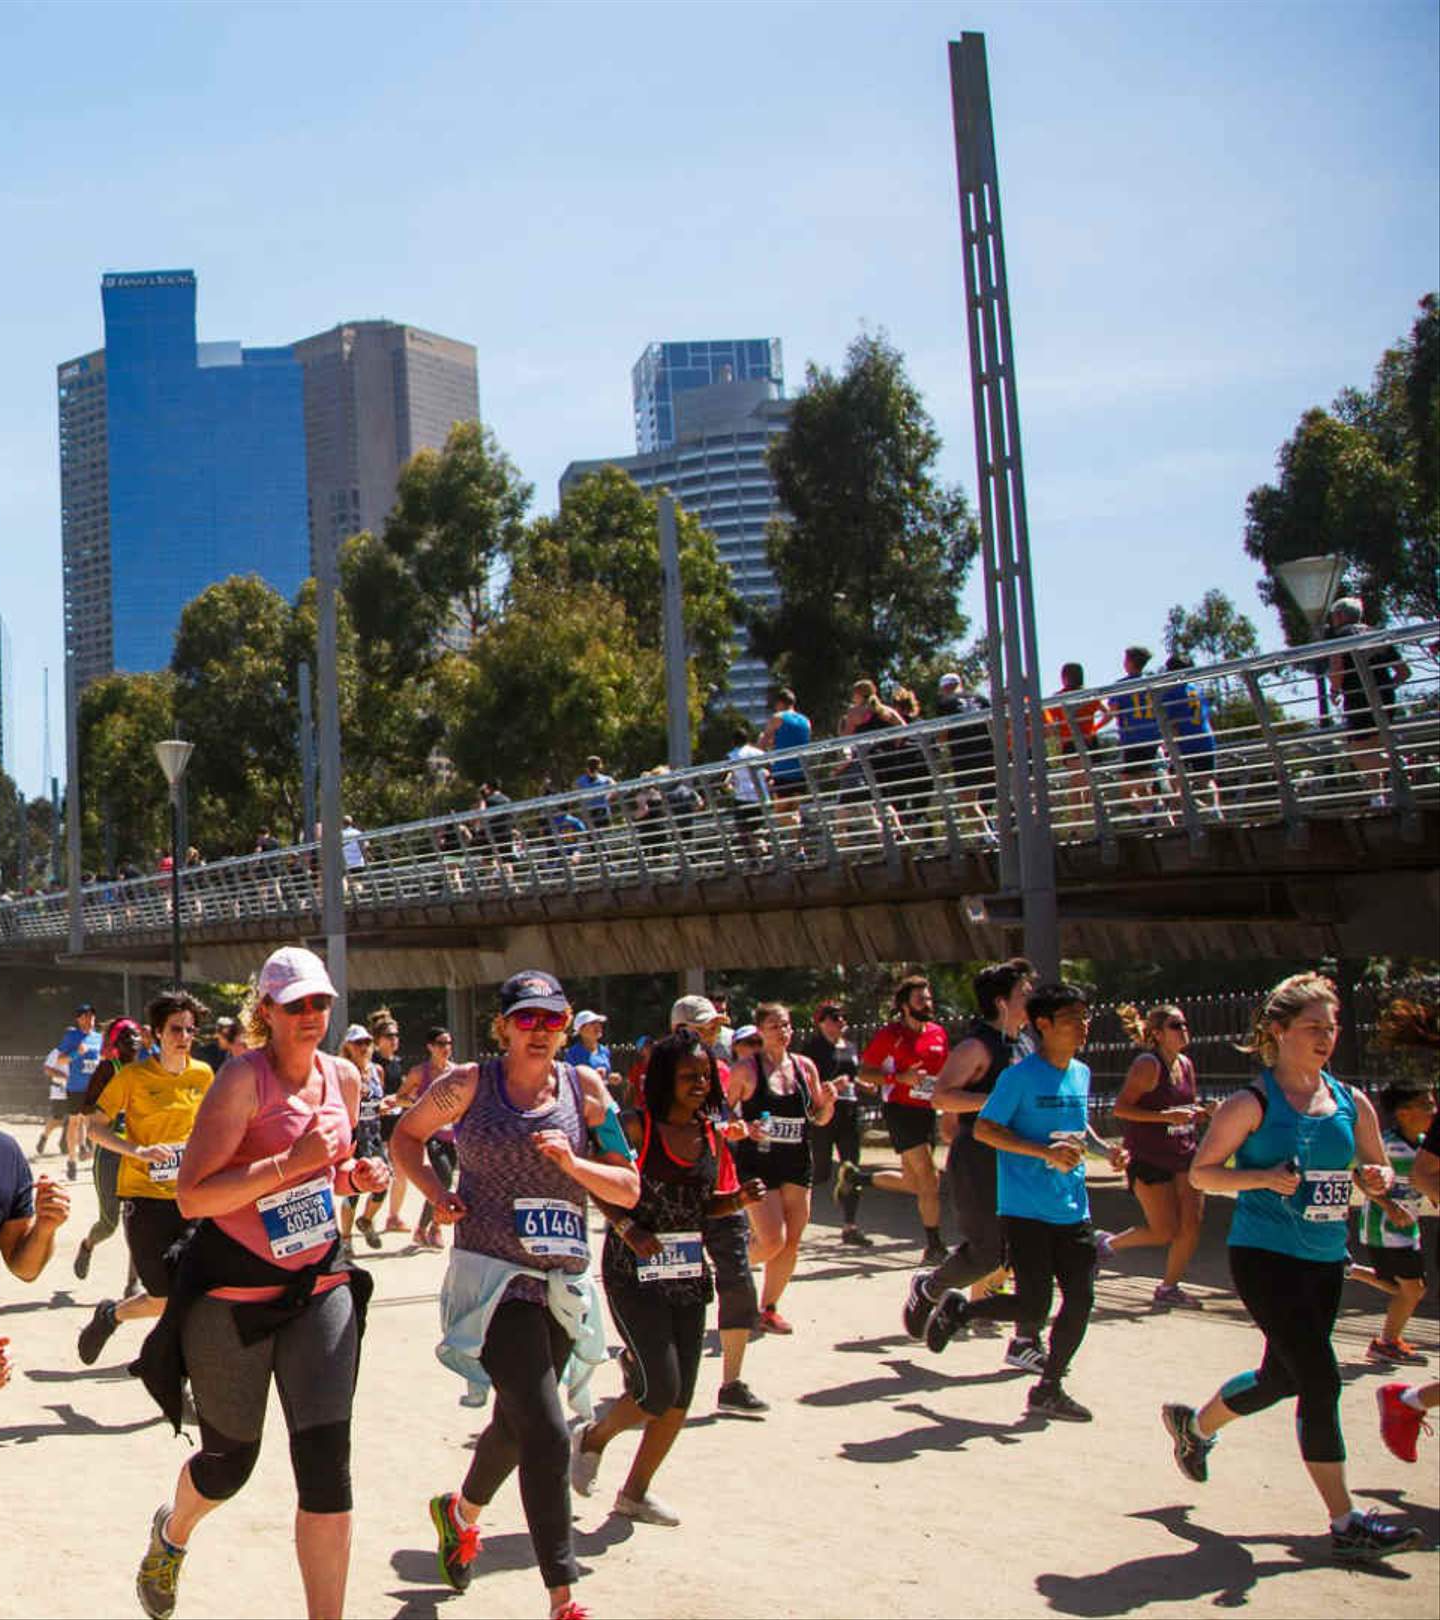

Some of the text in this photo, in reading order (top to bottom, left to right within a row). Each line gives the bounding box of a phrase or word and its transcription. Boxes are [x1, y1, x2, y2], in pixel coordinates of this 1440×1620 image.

[1313, 1183, 1349, 1205] 6353
[287, 1205, 328, 1233] 60570
[525, 1211, 581, 1239] 61461
